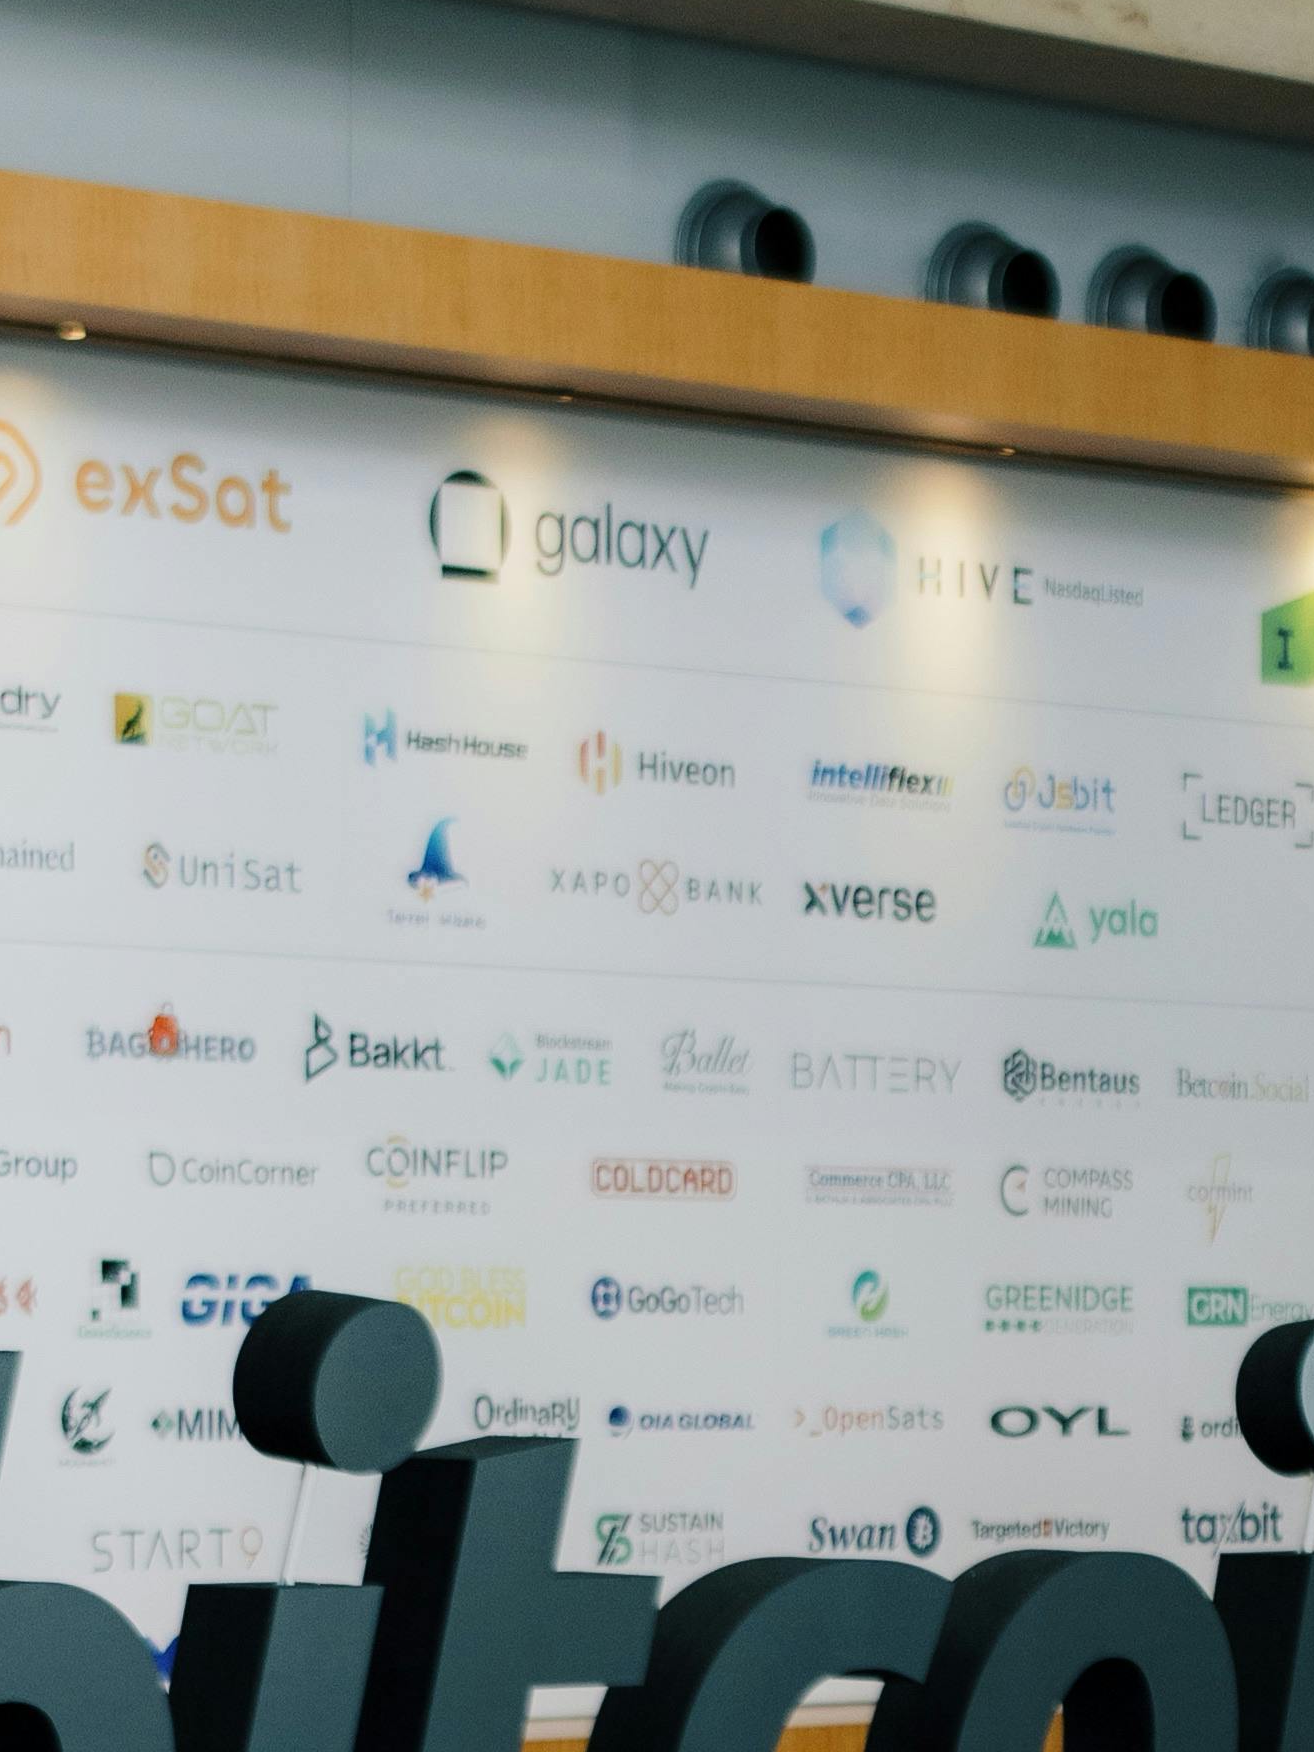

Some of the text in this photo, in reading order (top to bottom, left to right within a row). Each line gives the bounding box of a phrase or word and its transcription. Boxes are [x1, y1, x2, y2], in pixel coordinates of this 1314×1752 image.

[75, 451, 292, 534] exSat
[535, 502, 710, 590] galaxy
[918, 556, 1033, 605] HIVE
[159, 696, 278, 737] GOAT
[638, 751, 735, 789] Hiveon
[1201, 793, 1296, 830] LEDGER
[550, 867, 764, 907] XAPO BANK
[1088, 899, 1160, 945] yala
[349, 1032, 447, 1071] Bakkt
[661, 1028, 751, 1076] Ballet
[535, 1057, 613, 1085] JADE
[791, 1051, 962, 1094] BATTERY
[1039, 1062, 1140, 1095] Bentaus
[185, 1156, 319, 1186] CoinCorner
[366, 1146, 509, 1181] COINFLIP
[594, 1163, 734, 1196] COLDCARD
[1043, 1166, 1134, 1191] COMPASS
[383, 1198, 492, 1216] PREFERRED
[1043, 1196, 1114, 1219] MINING
[628, 1285, 745, 1317] GoGoTech
[985, 1284, 1134, 1313] GREENIDGE
[678, 1412, 755, 1432] GLOBAL
[990, 1405, 1131, 1438] OYL
[639, 1511, 725, 1534] SUSTAIN
[808, 1514, 897, 1552] Swan
[972, 1519, 1110, 1542] Targeted Victory
[1182, 1501, 1282, 1548] taxbit
